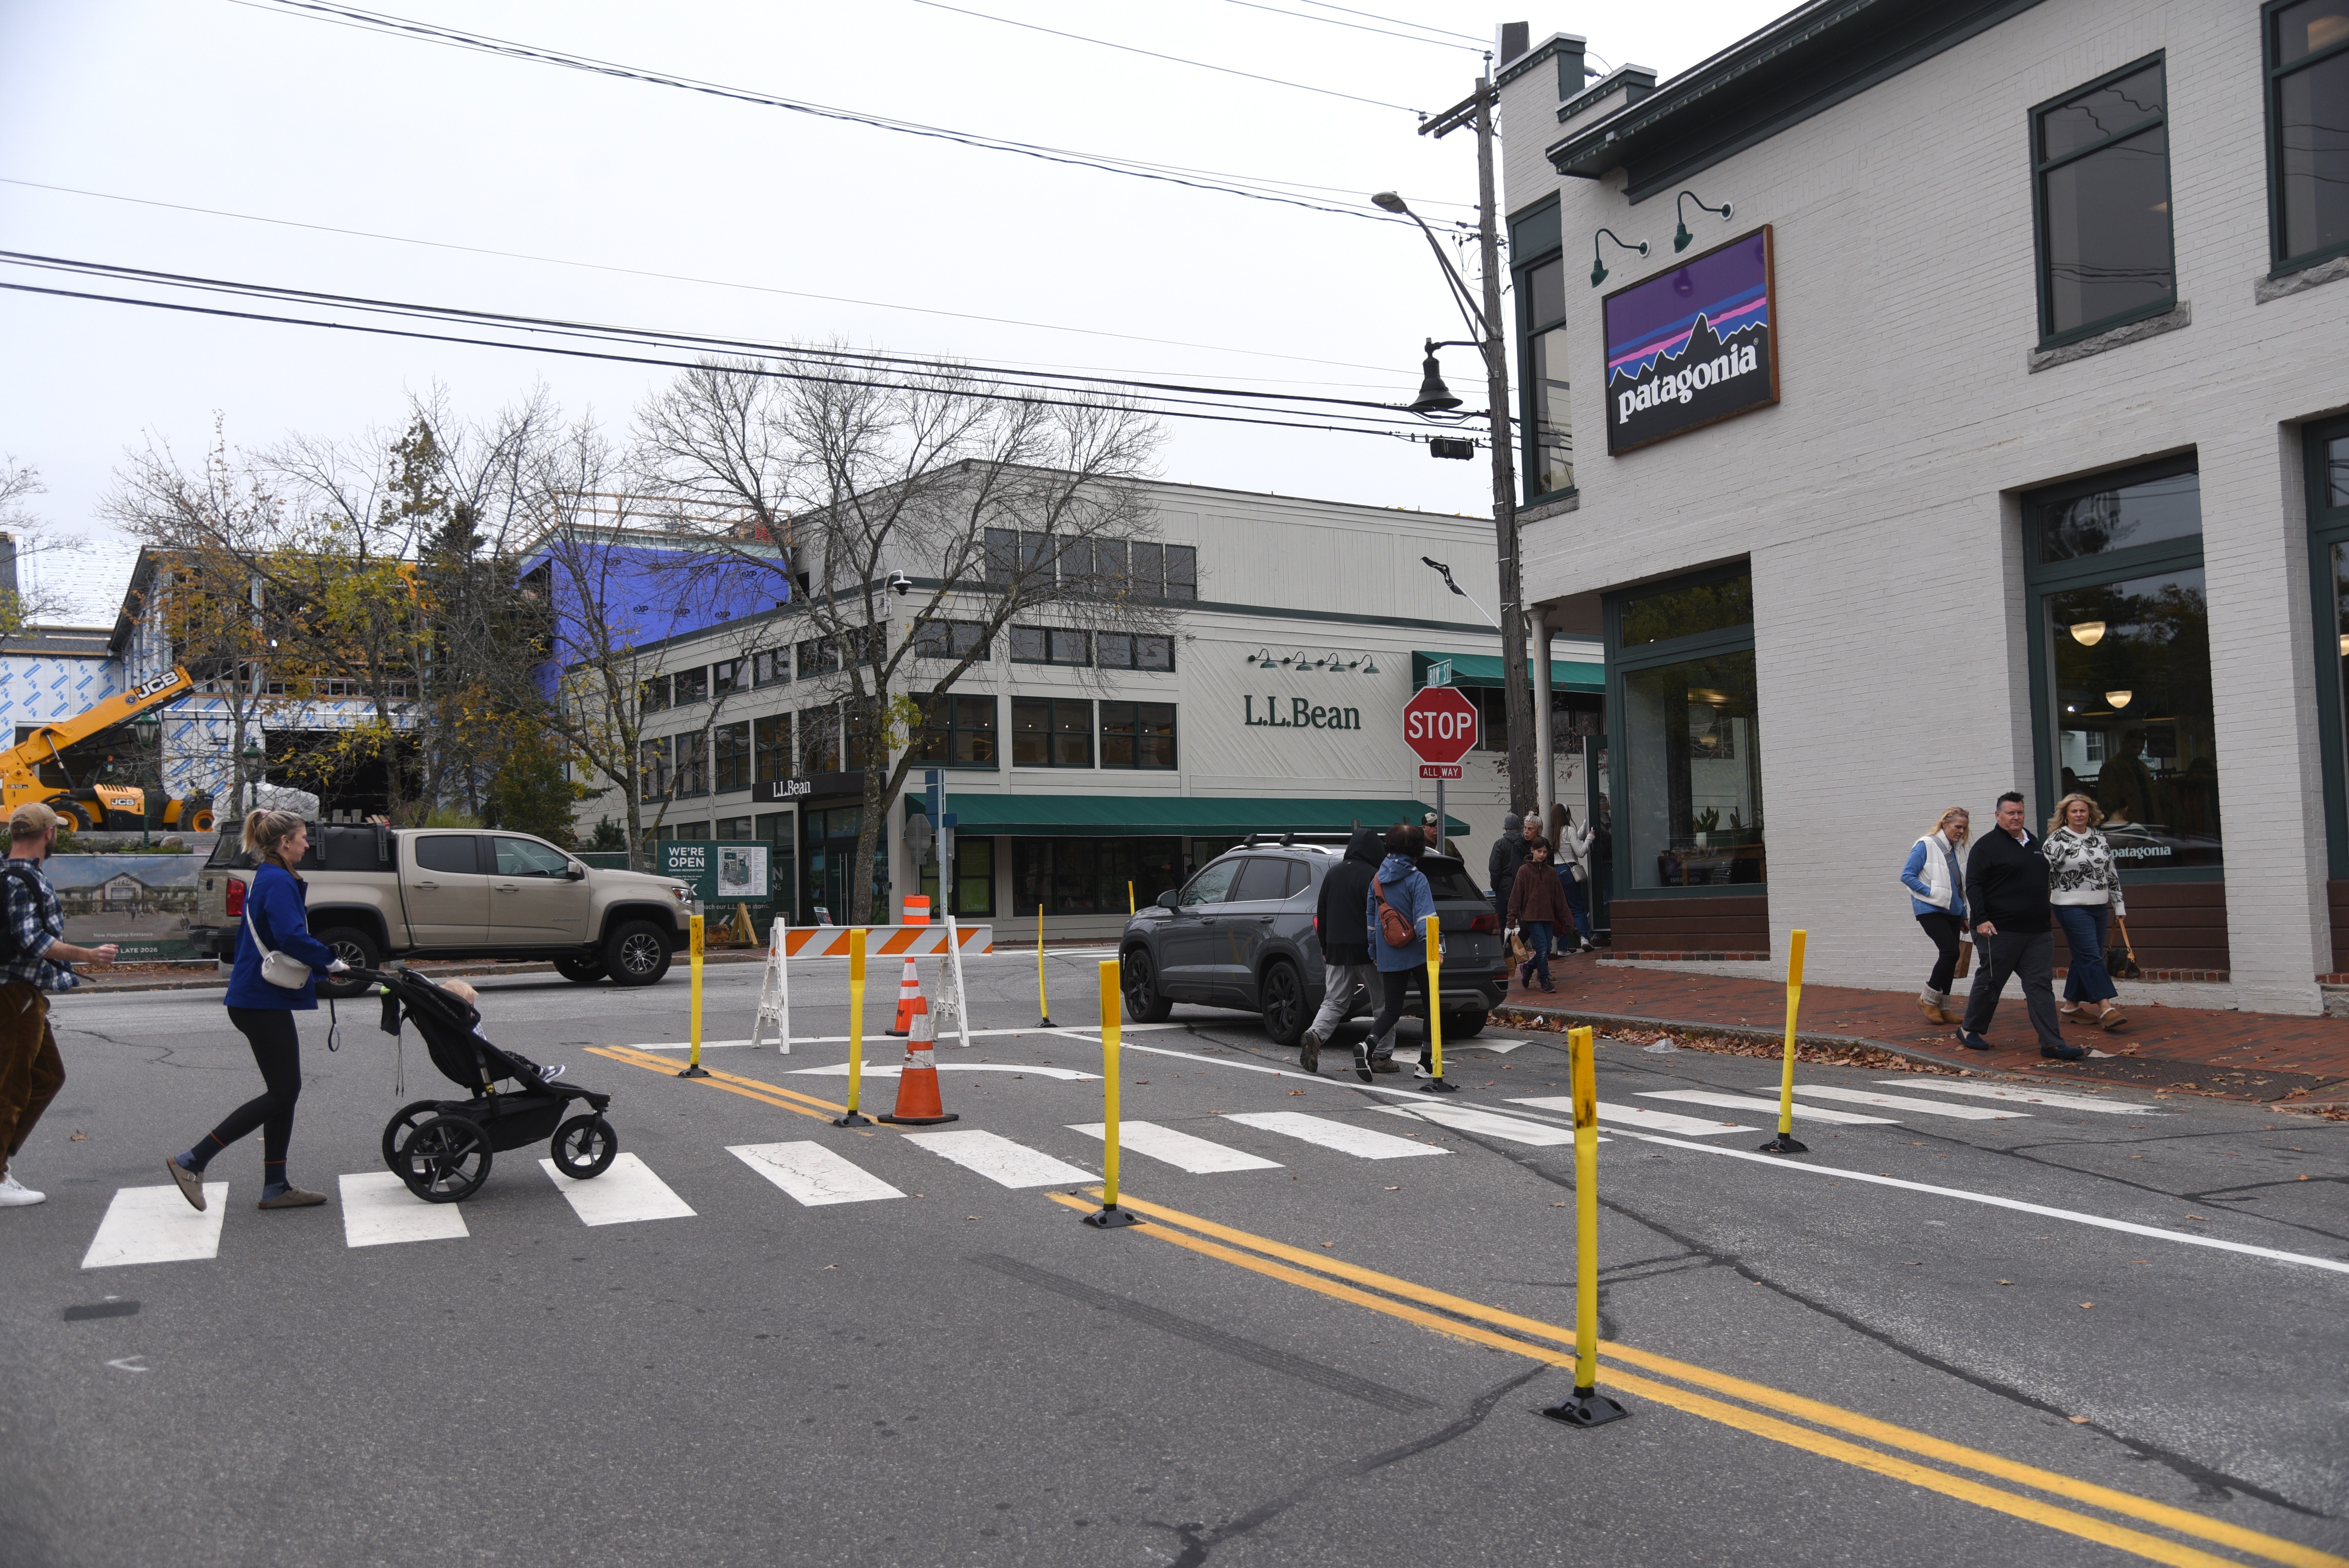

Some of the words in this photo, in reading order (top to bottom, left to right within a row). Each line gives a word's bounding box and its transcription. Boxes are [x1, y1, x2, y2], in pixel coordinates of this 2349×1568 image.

[1618, 343, 1757, 424] patagonia
[1429, 666, 1440, 685] BOW
[1444, 663, 1449, 681] ST
[138, 671, 179, 698] JCB
[1244, 695, 1361, 729] L.L.Bean
[1408, 711, 1472, 739] STOP
[1423, 768, 1438, 776] ALL
[1442, 768, 1458, 776] WAY
[773, 780, 811, 797] L.L.Bean
[668, 847, 704, 856] WE'RE
[2110, 846, 2171, 859] patagonia
[669, 857, 704, 867] OPEN
